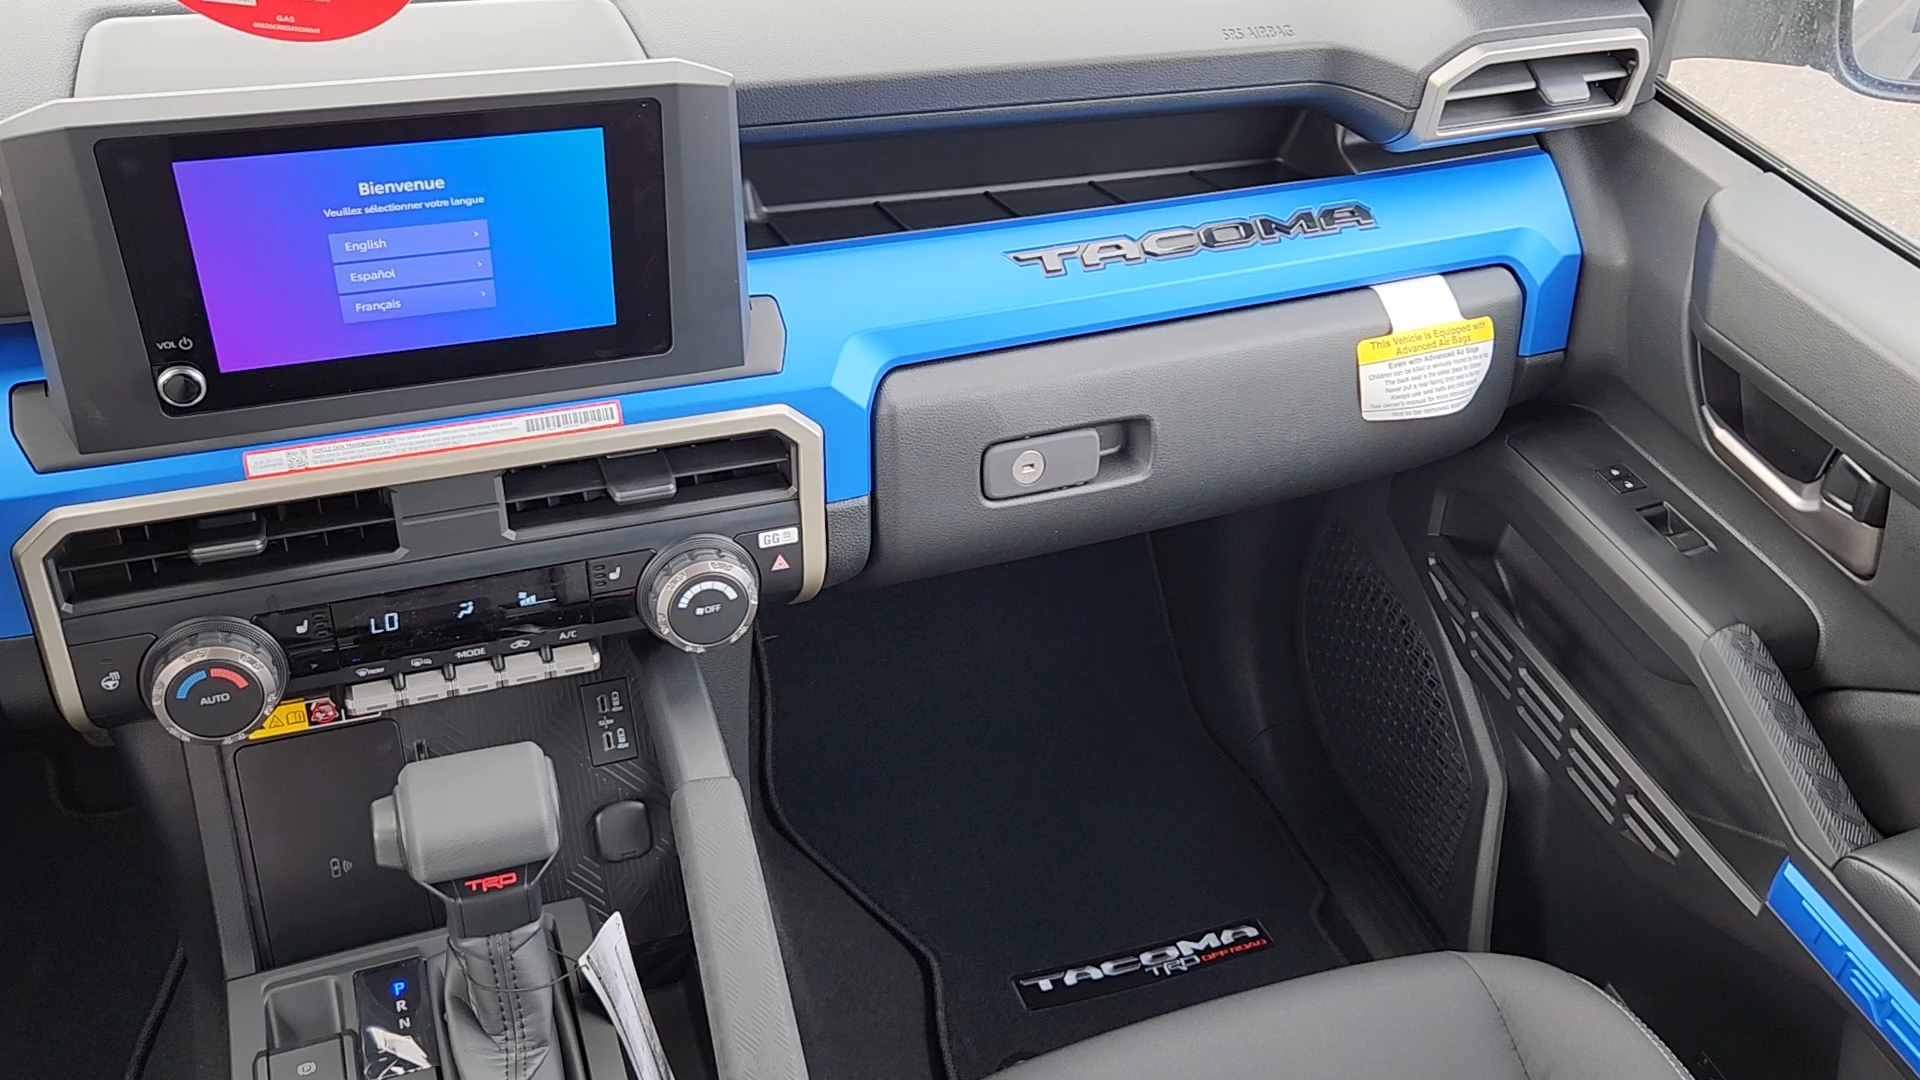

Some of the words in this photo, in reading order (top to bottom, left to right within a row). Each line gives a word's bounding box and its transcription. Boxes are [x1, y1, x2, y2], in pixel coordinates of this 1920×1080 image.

[276, 14, 295, 23] GAS
[1221, 27, 1245, 40] SRS
[1247, 24, 1295, 39] AIRBAG
[358, 178, 446, 196] Bienvenue
[322, 207, 363, 218] Veuillez
[364, 201, 423, 214] sélectionner
[424, 199, 450, 209] votre
[450, 196, 485, 208] langue
[344, 238, 388, 253] English
[1004, 201, 1378, 276] TACOMA
[350, 268, 397, 283] Español
[355, 299, 402, 313] Français
[1370, 340, 1392, 351] This
[1392, 333, 1422, 346] Vehicle
[1433, 323, 1471, 341] Equipped
[1472, 321, 1487, 330] with
[156, 341, 178, 350] VOL
[1396, 341, 1437, 356] Advanced
[1439, 338, 1450, 347] Air
[1451, 334, 1472, 345] Bags
[1388, 360, 1408, 370] Even
[1408, 357, 1423, 366] with
[1424, 350, 1455, 363] Advanced
[1457, 348, 1465, 356] Air
[1465, 346, 1480, 354] Bags
[1368, 371, 1392, 381] Children
[763, 532, 781, 546] GG
[704, 604, 722, 614] OFF
[370, 611, 399, 635] LO
[559, 630, 578, 640] A/C
[458, 647, 487, 659] MODE
[200, 692, 231, 706] AUTO
[464, 872, 518, 892] TRD
[1019, 924, 1260, 992] TACOMA
[1144, 954, 1201, 976] TRD
[1201, 948, 1229, 963] OFF
[1230, 938, 1267, 954] ROAD
[393, 982, 406, 997] P
[396, 999, 408, 1013] R
[399, 1016, 411, 1030] N
